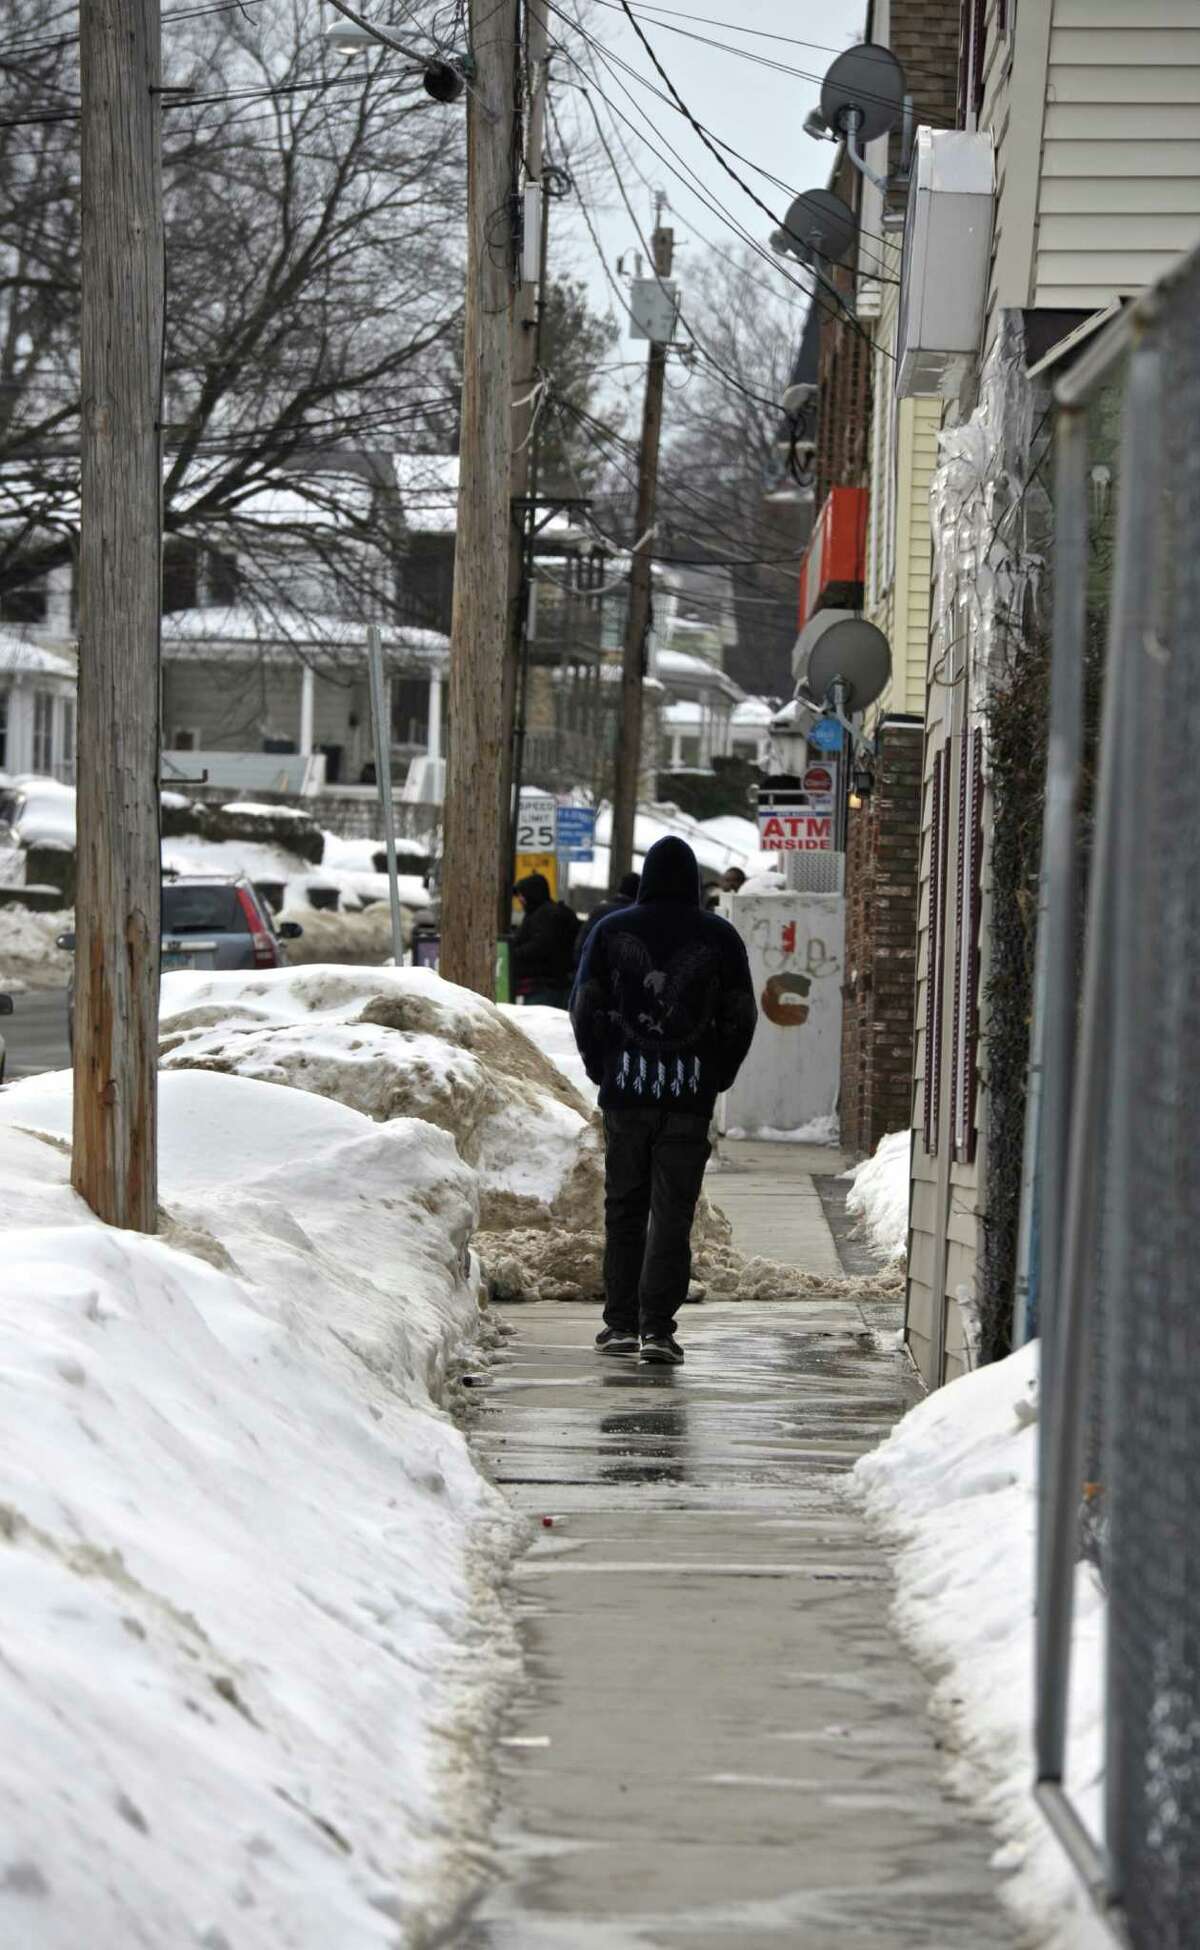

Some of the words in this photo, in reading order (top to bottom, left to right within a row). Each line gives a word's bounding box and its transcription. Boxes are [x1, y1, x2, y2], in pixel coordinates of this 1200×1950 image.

[519, 802, 553, 811] SPEED
[521, 813, 550, 823] LIMIT
[763, 818, 832, 837] ATM
[518, 826, 553, 846] 25
[762, 839, 831, 850] INSIDE
